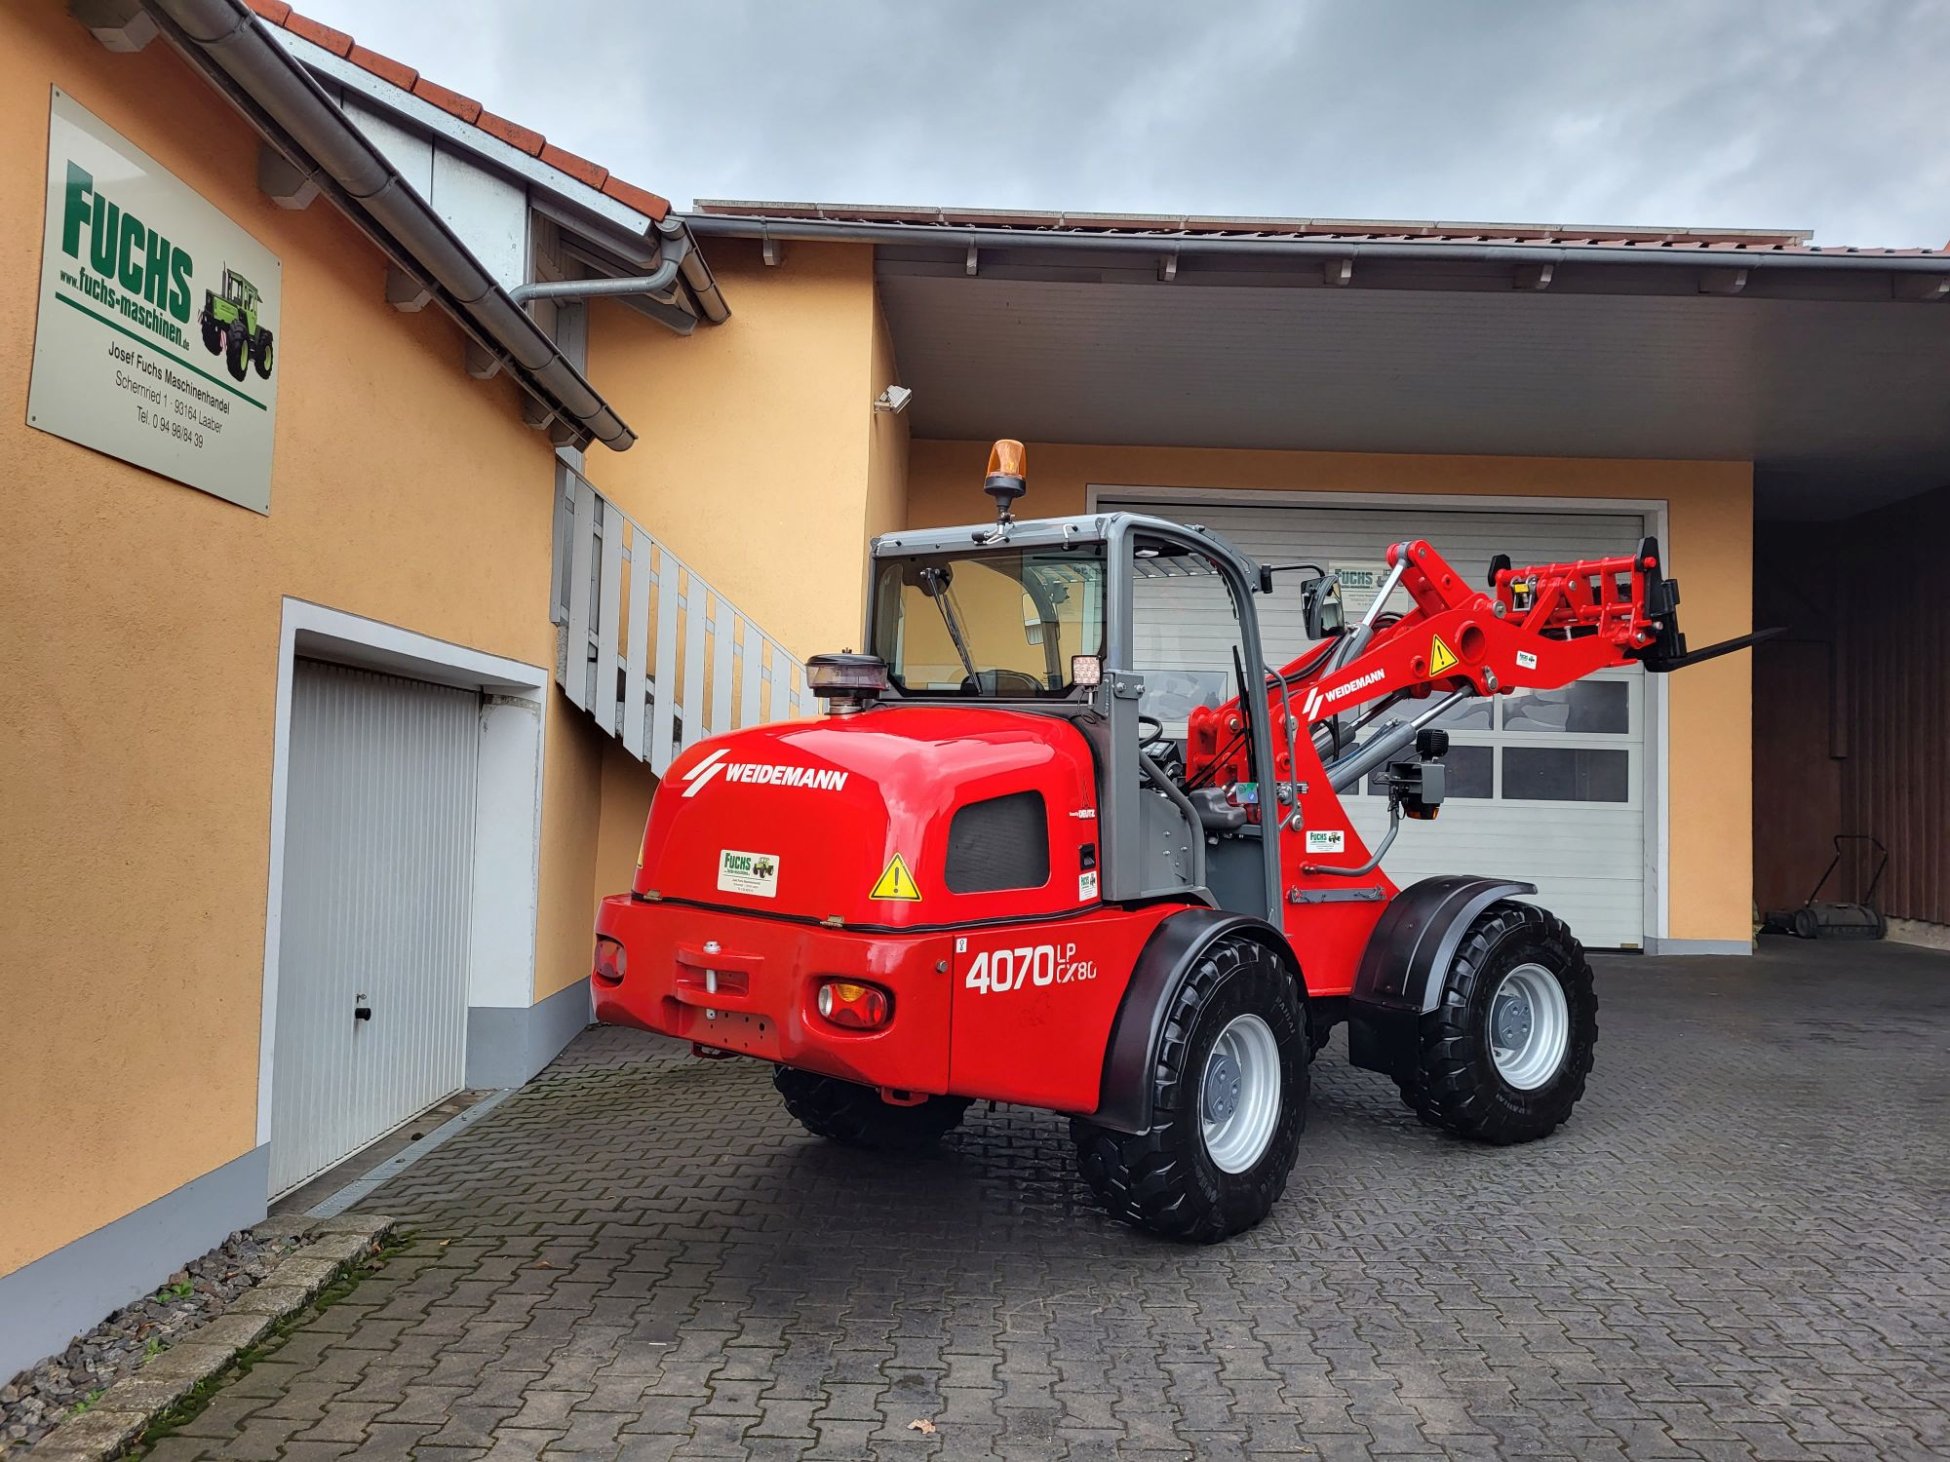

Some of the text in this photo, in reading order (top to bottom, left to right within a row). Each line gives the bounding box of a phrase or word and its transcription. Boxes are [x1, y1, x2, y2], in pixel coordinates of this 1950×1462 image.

[62, 159, 193, 324] FUCHS
[60, 267, 190, 351] www.fuchs-maschinen.de
[109, 341, 230, 415] Josef Fuchs Maschinenhandel
[137, 405, 150, 425] Tel.
[152, 414, 158, 429] 0
[160, 417, 170, 434] 94
[194, 433, 204, 449] 39
[164, 394, 168, 408] 1
[174, 399, 197, 421] 93164
[198, 410, 222, 434] Laaber
[1325, 668, 1385, 702] WEIDEMANN
[726, 763, 848, 791] WEIDEMANN
[724, 852, 751, 871] FUCHS
[966, 943, 1076, 994] 4070 LP
